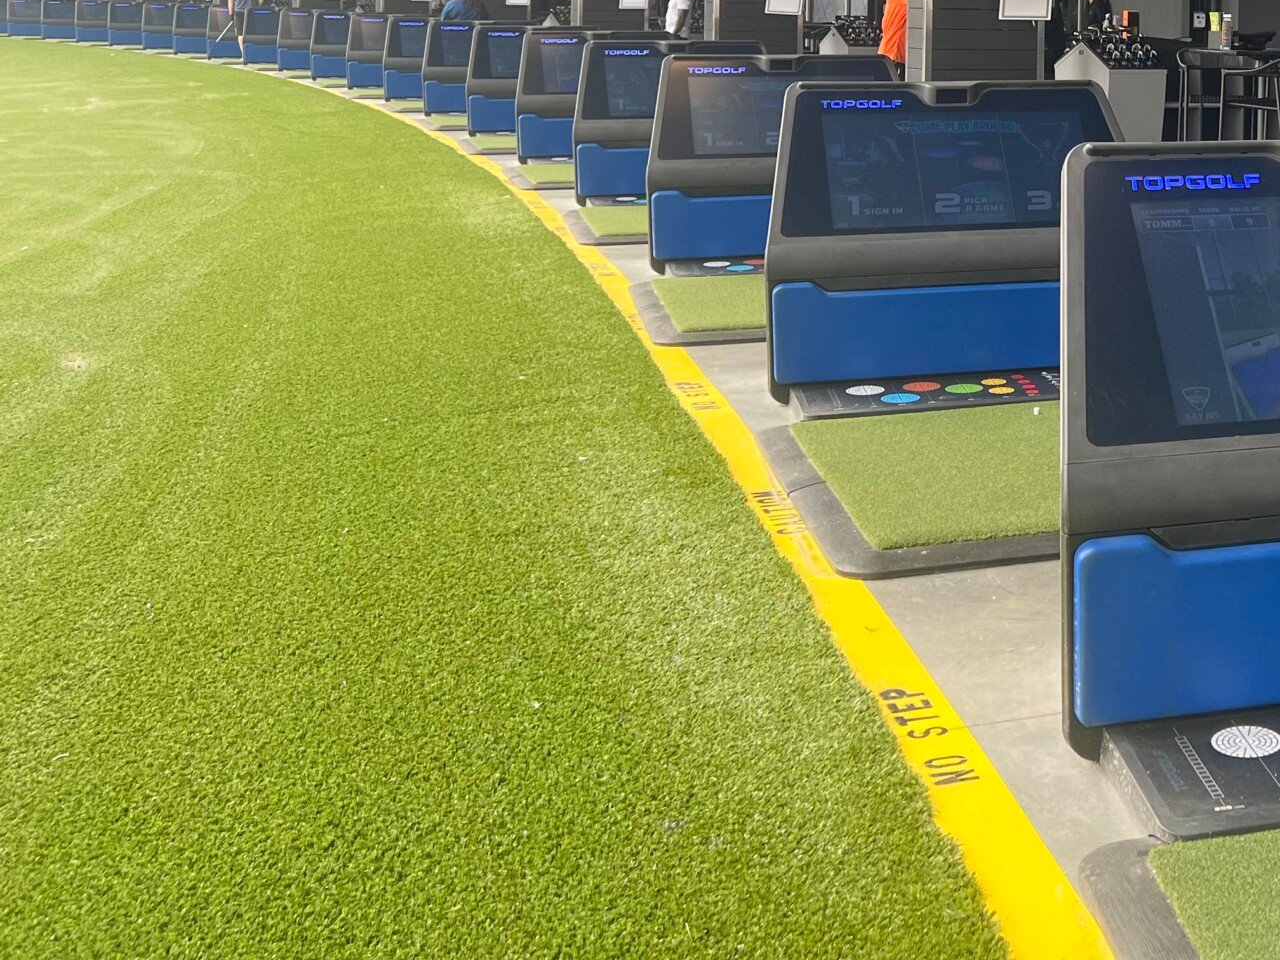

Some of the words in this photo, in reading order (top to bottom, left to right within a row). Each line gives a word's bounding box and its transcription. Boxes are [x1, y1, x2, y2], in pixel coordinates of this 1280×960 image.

[687, 66, 746, 74] TOPGOLF
[821, 99, 903, 109] TOPGOLF
[1124, 173, 1261, 191] TOPGOLF
[847, 195, 860, 216] 1
[935, 192, 961, 213] 2
[964, 196, 987, 205] PICK
[976, 203, 1005, 212] GAME
[1026, 190, 1052, 211] 3
[864, 207, 890, 216] SIGN
[892, 207, 903, 215] IN
[1247, 217, 1254, 226] 9
[880, 689, 949, 739] STEP
[924, 755, 981, 786] NO
